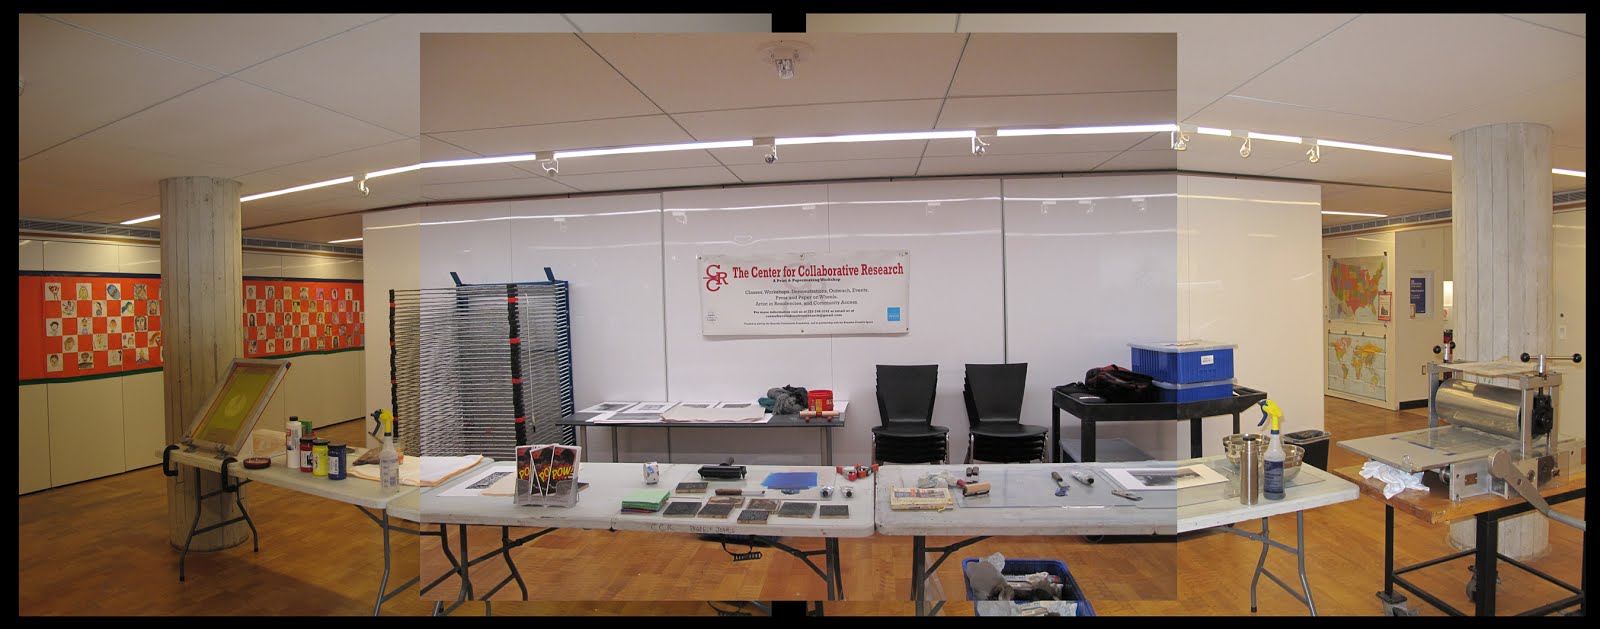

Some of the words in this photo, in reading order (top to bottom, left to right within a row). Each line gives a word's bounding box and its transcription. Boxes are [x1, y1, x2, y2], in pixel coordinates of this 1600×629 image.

[732, 266, 749, 279] The
[751, 266, 781, 279] Center
[783, 265, 796, 278] for
[797, 264, 859, 277] Collaborative
[860, 262, 904, 276] Research
[519, 466, 530, 480] PO
[539, 465, 551, 483] PO
